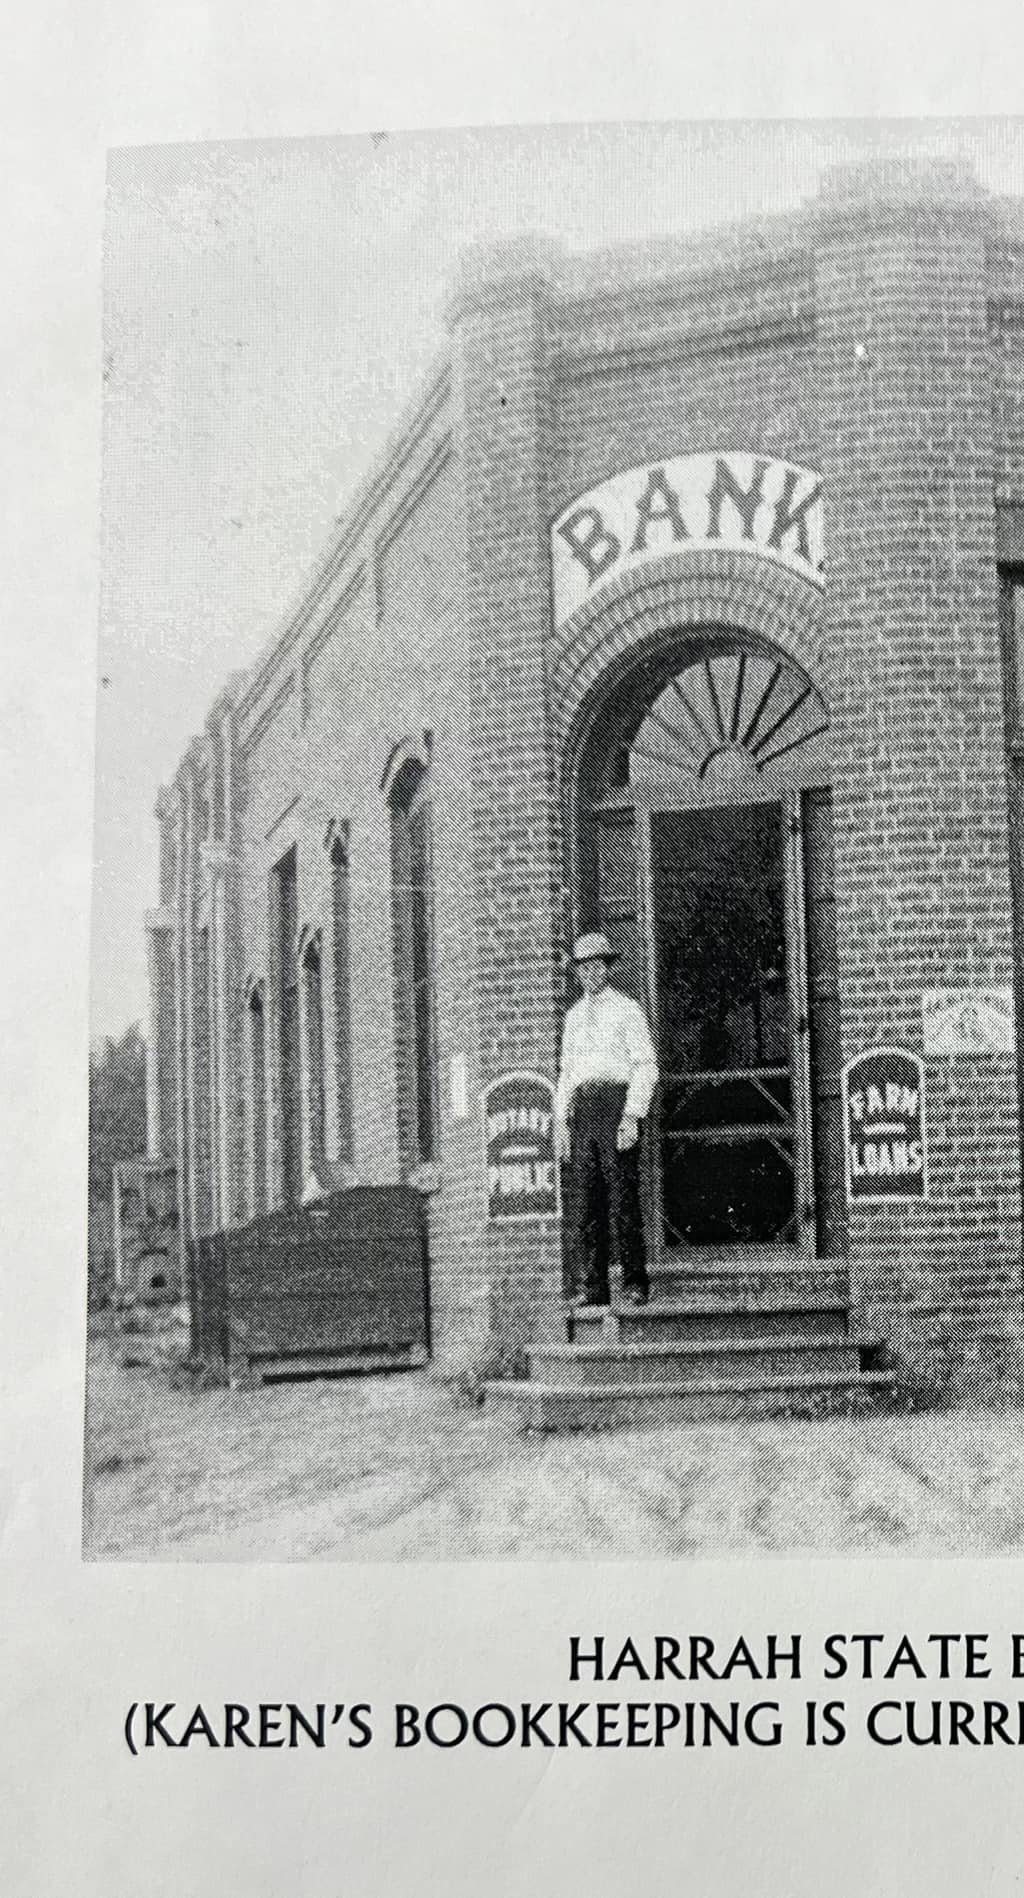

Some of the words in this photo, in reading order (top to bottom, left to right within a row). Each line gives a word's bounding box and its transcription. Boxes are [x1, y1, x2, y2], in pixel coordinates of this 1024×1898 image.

[556, 458, 824, 586] BANK
[850, 1084, 919, 1121] FARM
[852, 1141, 923, 1176] LOANS
[569, 1635, 802, 1681] HARRAH
[824, 1634, 992, 1680] STATE
[124, 1701, 372, 1756] (KAREN'S
[394, 1701, 783, 1748] BOOKKEEPING
[806, 1701, 846, 1746] IS
